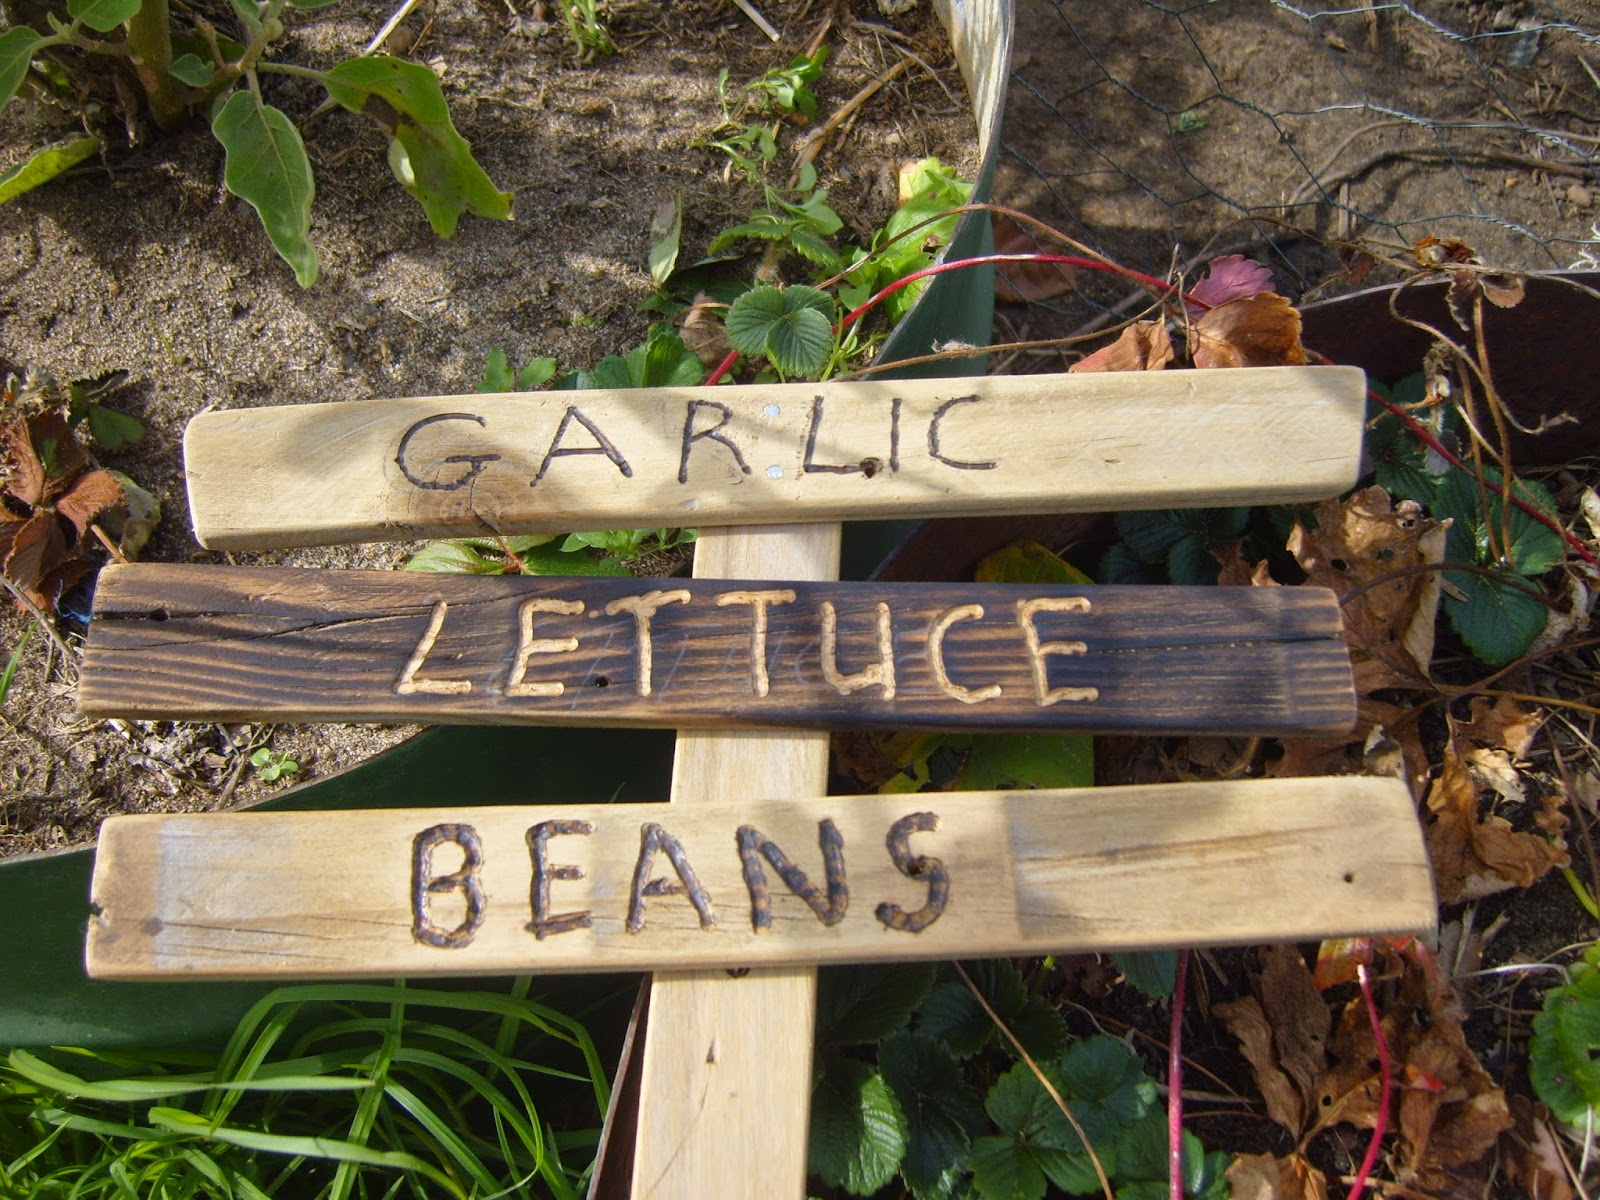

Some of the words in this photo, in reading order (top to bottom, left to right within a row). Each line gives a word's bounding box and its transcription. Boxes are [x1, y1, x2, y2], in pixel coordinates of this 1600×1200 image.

[395, 394, 997, 491] GARLIC
[394, 588, 1100, 706] LETTUCE
[411, 811, 951, 949] BEANS
